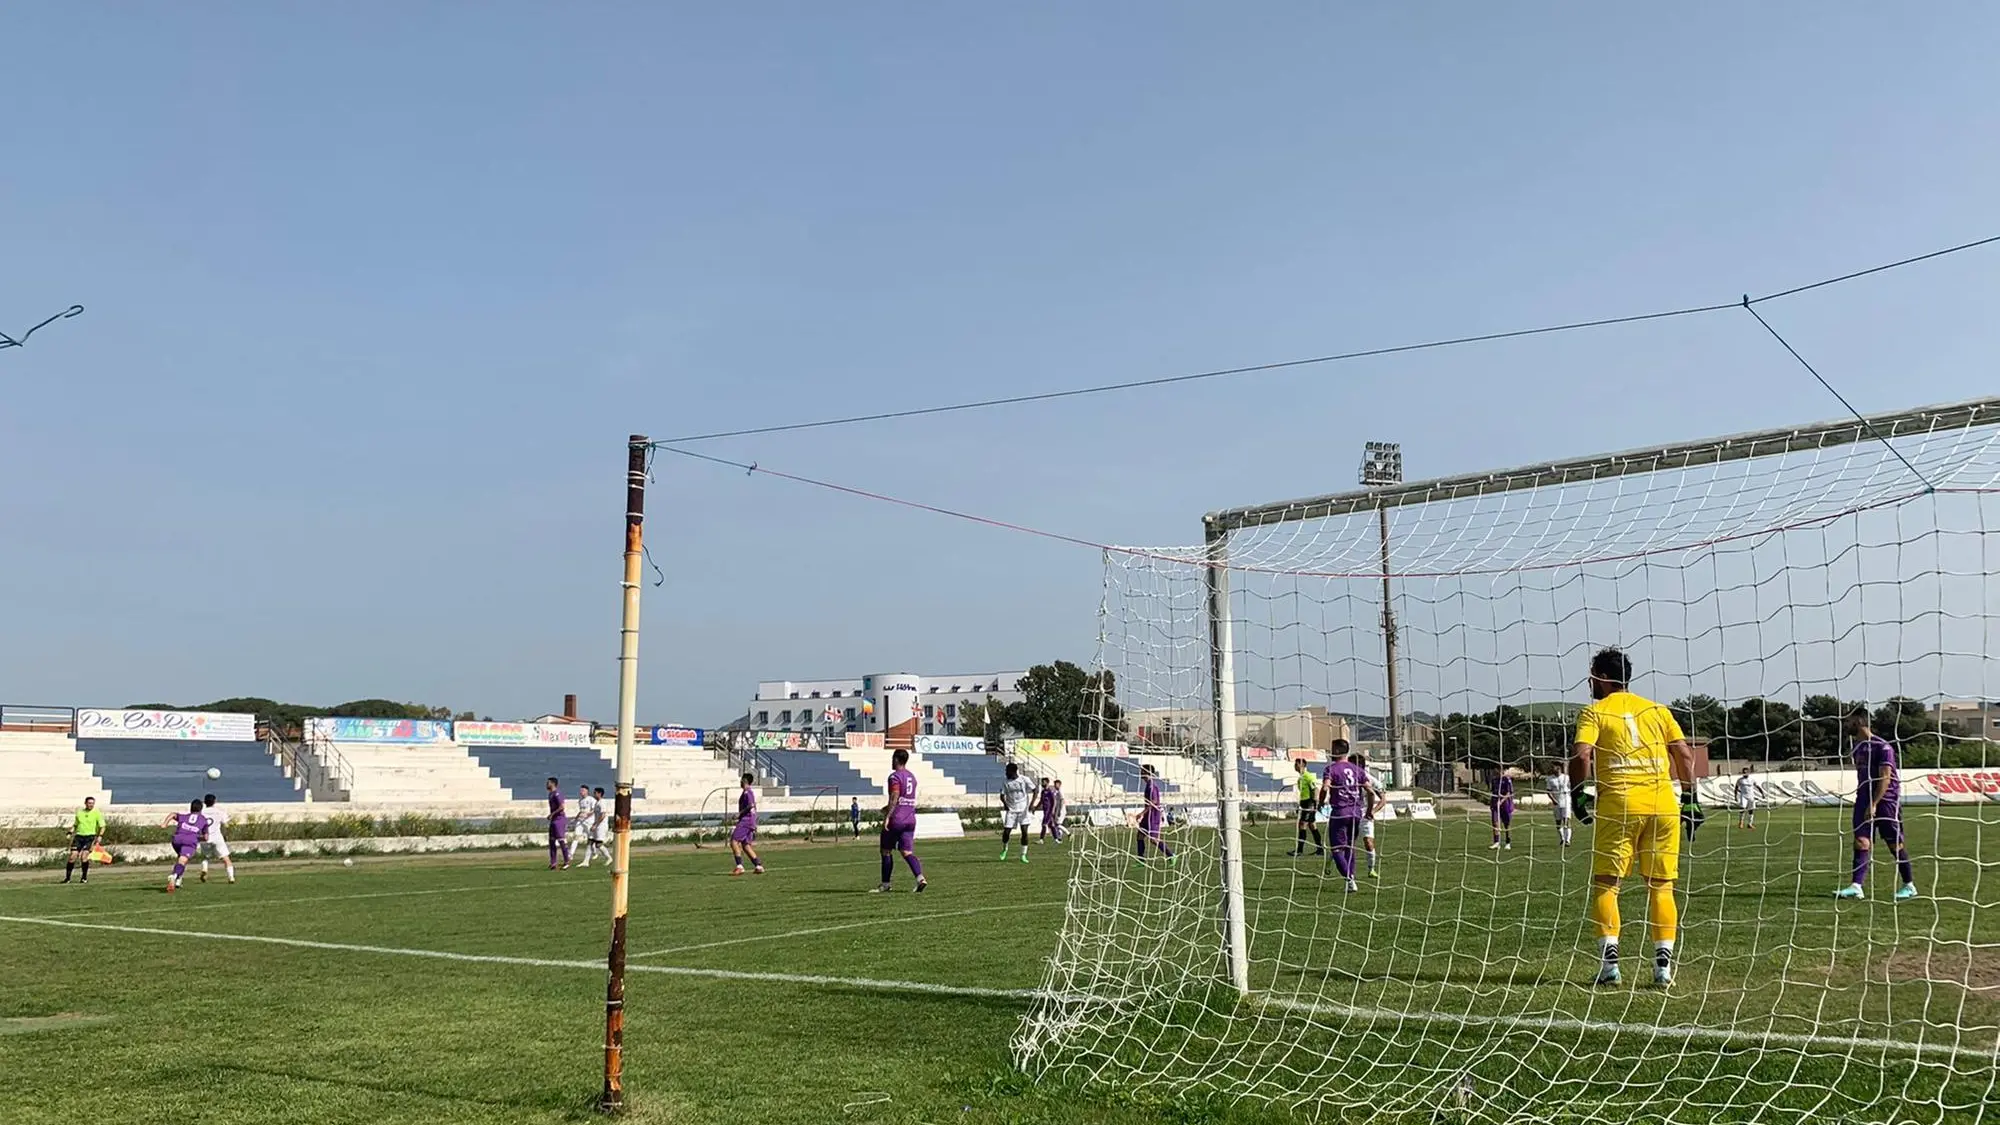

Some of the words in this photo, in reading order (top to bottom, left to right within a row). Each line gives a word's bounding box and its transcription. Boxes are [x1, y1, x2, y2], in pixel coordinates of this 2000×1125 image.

[1624, 712, 1641, 748] 1
[933, 740, 974, 751] GAVIANO
[906, 777, 913, 795] 5
[1343, 768, 1355, 786] 3
